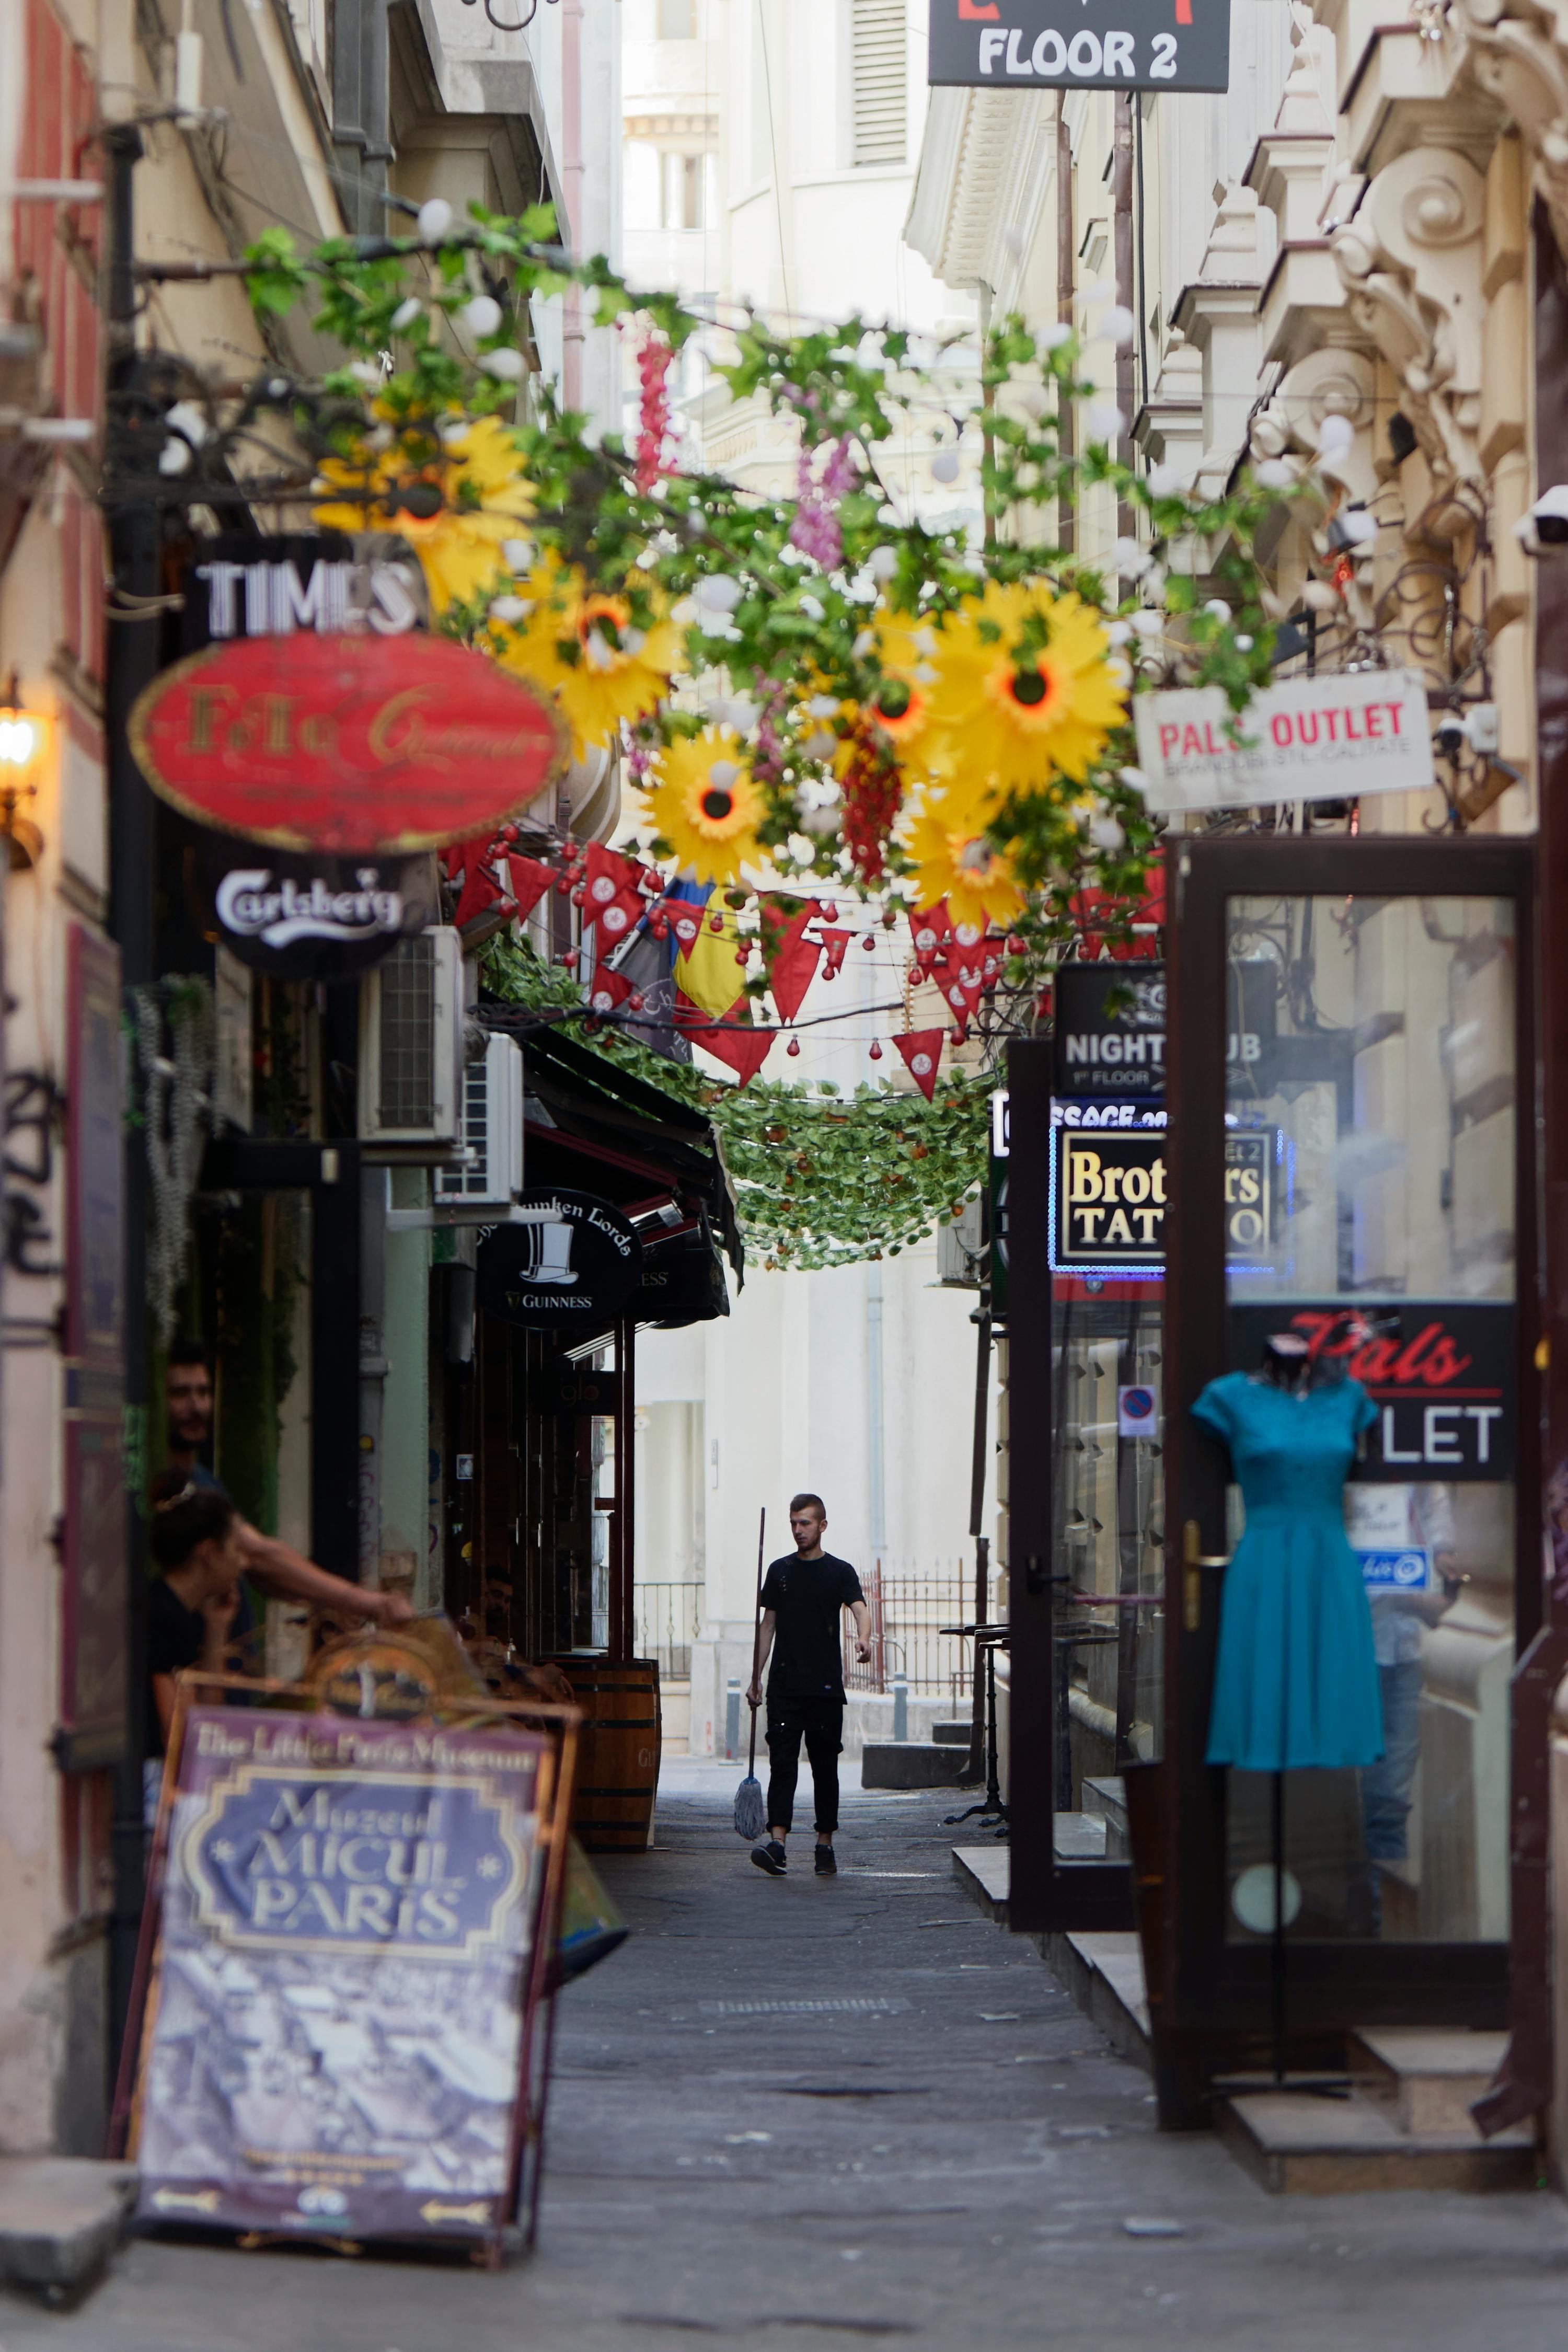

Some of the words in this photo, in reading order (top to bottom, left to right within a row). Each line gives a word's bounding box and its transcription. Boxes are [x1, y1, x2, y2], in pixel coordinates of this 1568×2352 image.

[979, 28, 1136, 77] FLOOR
[1149, 32, 1178, 79] 2
[195, 559, 418, 637] TIMES
[1270, 701, 1404, 747] OUTLET
[215, 869, 405, 942] Carlsberg
[1092, 1070, 1150, 1086] FLOOR
[586, 1207, 631, 1256] Lords
[523, 1294, 593, 1308] GUINNESS
[1290, 1309, 1473, 1386] Pals
[1382, 1405, 1503, 1463] LET
[270, 1787, 443, 1837] Muzeul
